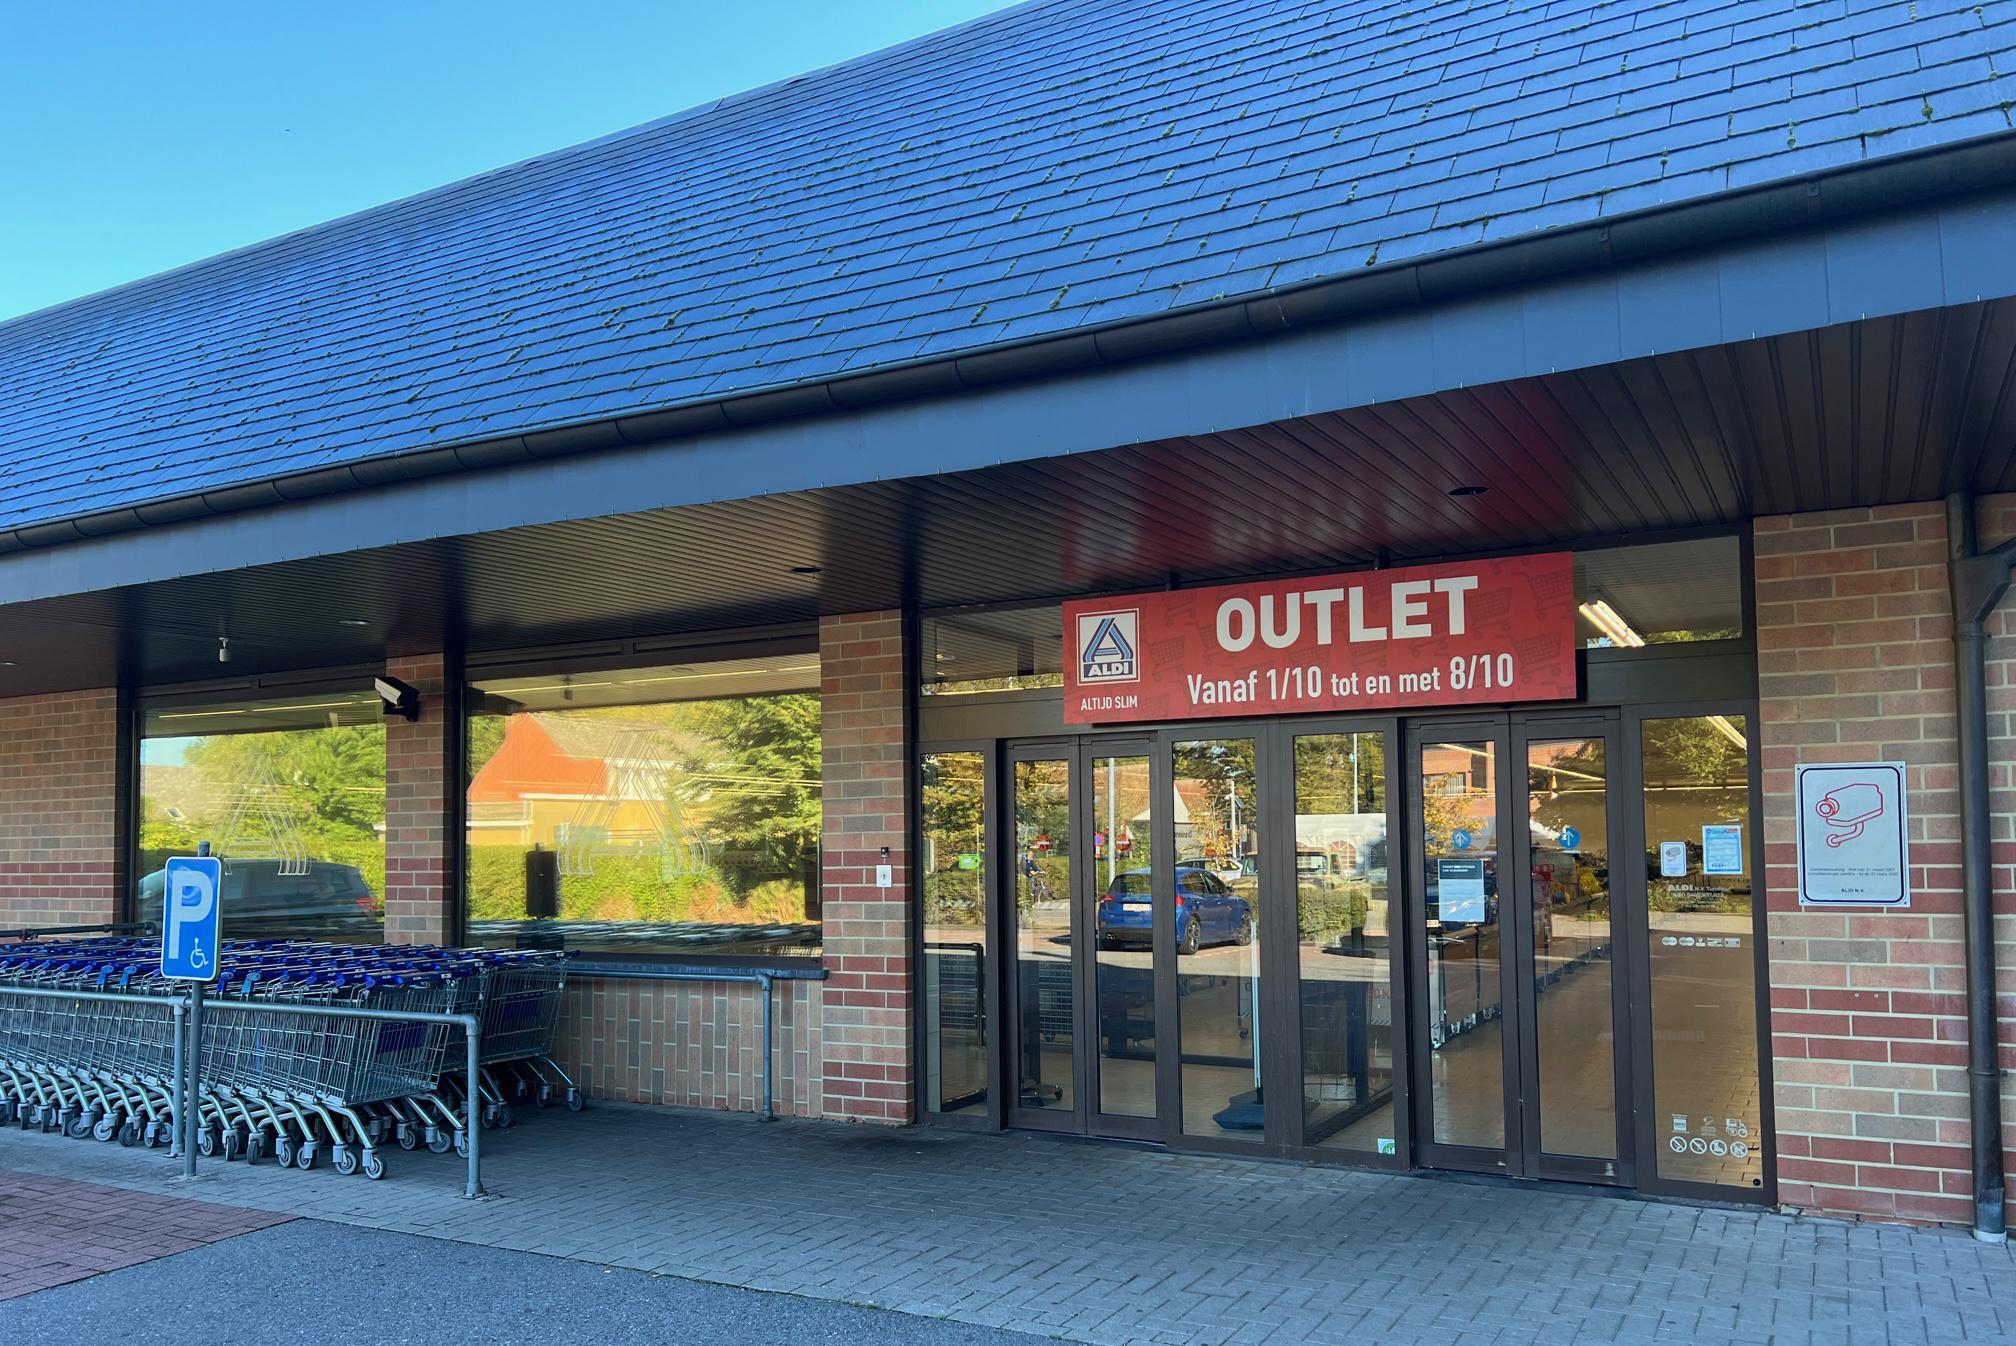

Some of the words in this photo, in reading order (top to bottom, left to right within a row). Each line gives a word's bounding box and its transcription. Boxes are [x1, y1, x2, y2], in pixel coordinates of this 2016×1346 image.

[1216, 576, 1479, 652] OUTLET
[1088, 662, 1129, 677] ALDI
[1187, 671, 1257, 705] Vanaf
[1266, 665, 1322, 700] 1/10
[1331, 672, 1359, 696] tot
[1365, 674, 1391, 694] en
[1399, 666, 1440, 693] met
[1450, 653, 1513, 690] 8/10
[1081, 696, 1112, 710] ALTIJD
[1114, 695, 1138, 708] SLIM
[168, 870, 214, 960] P
